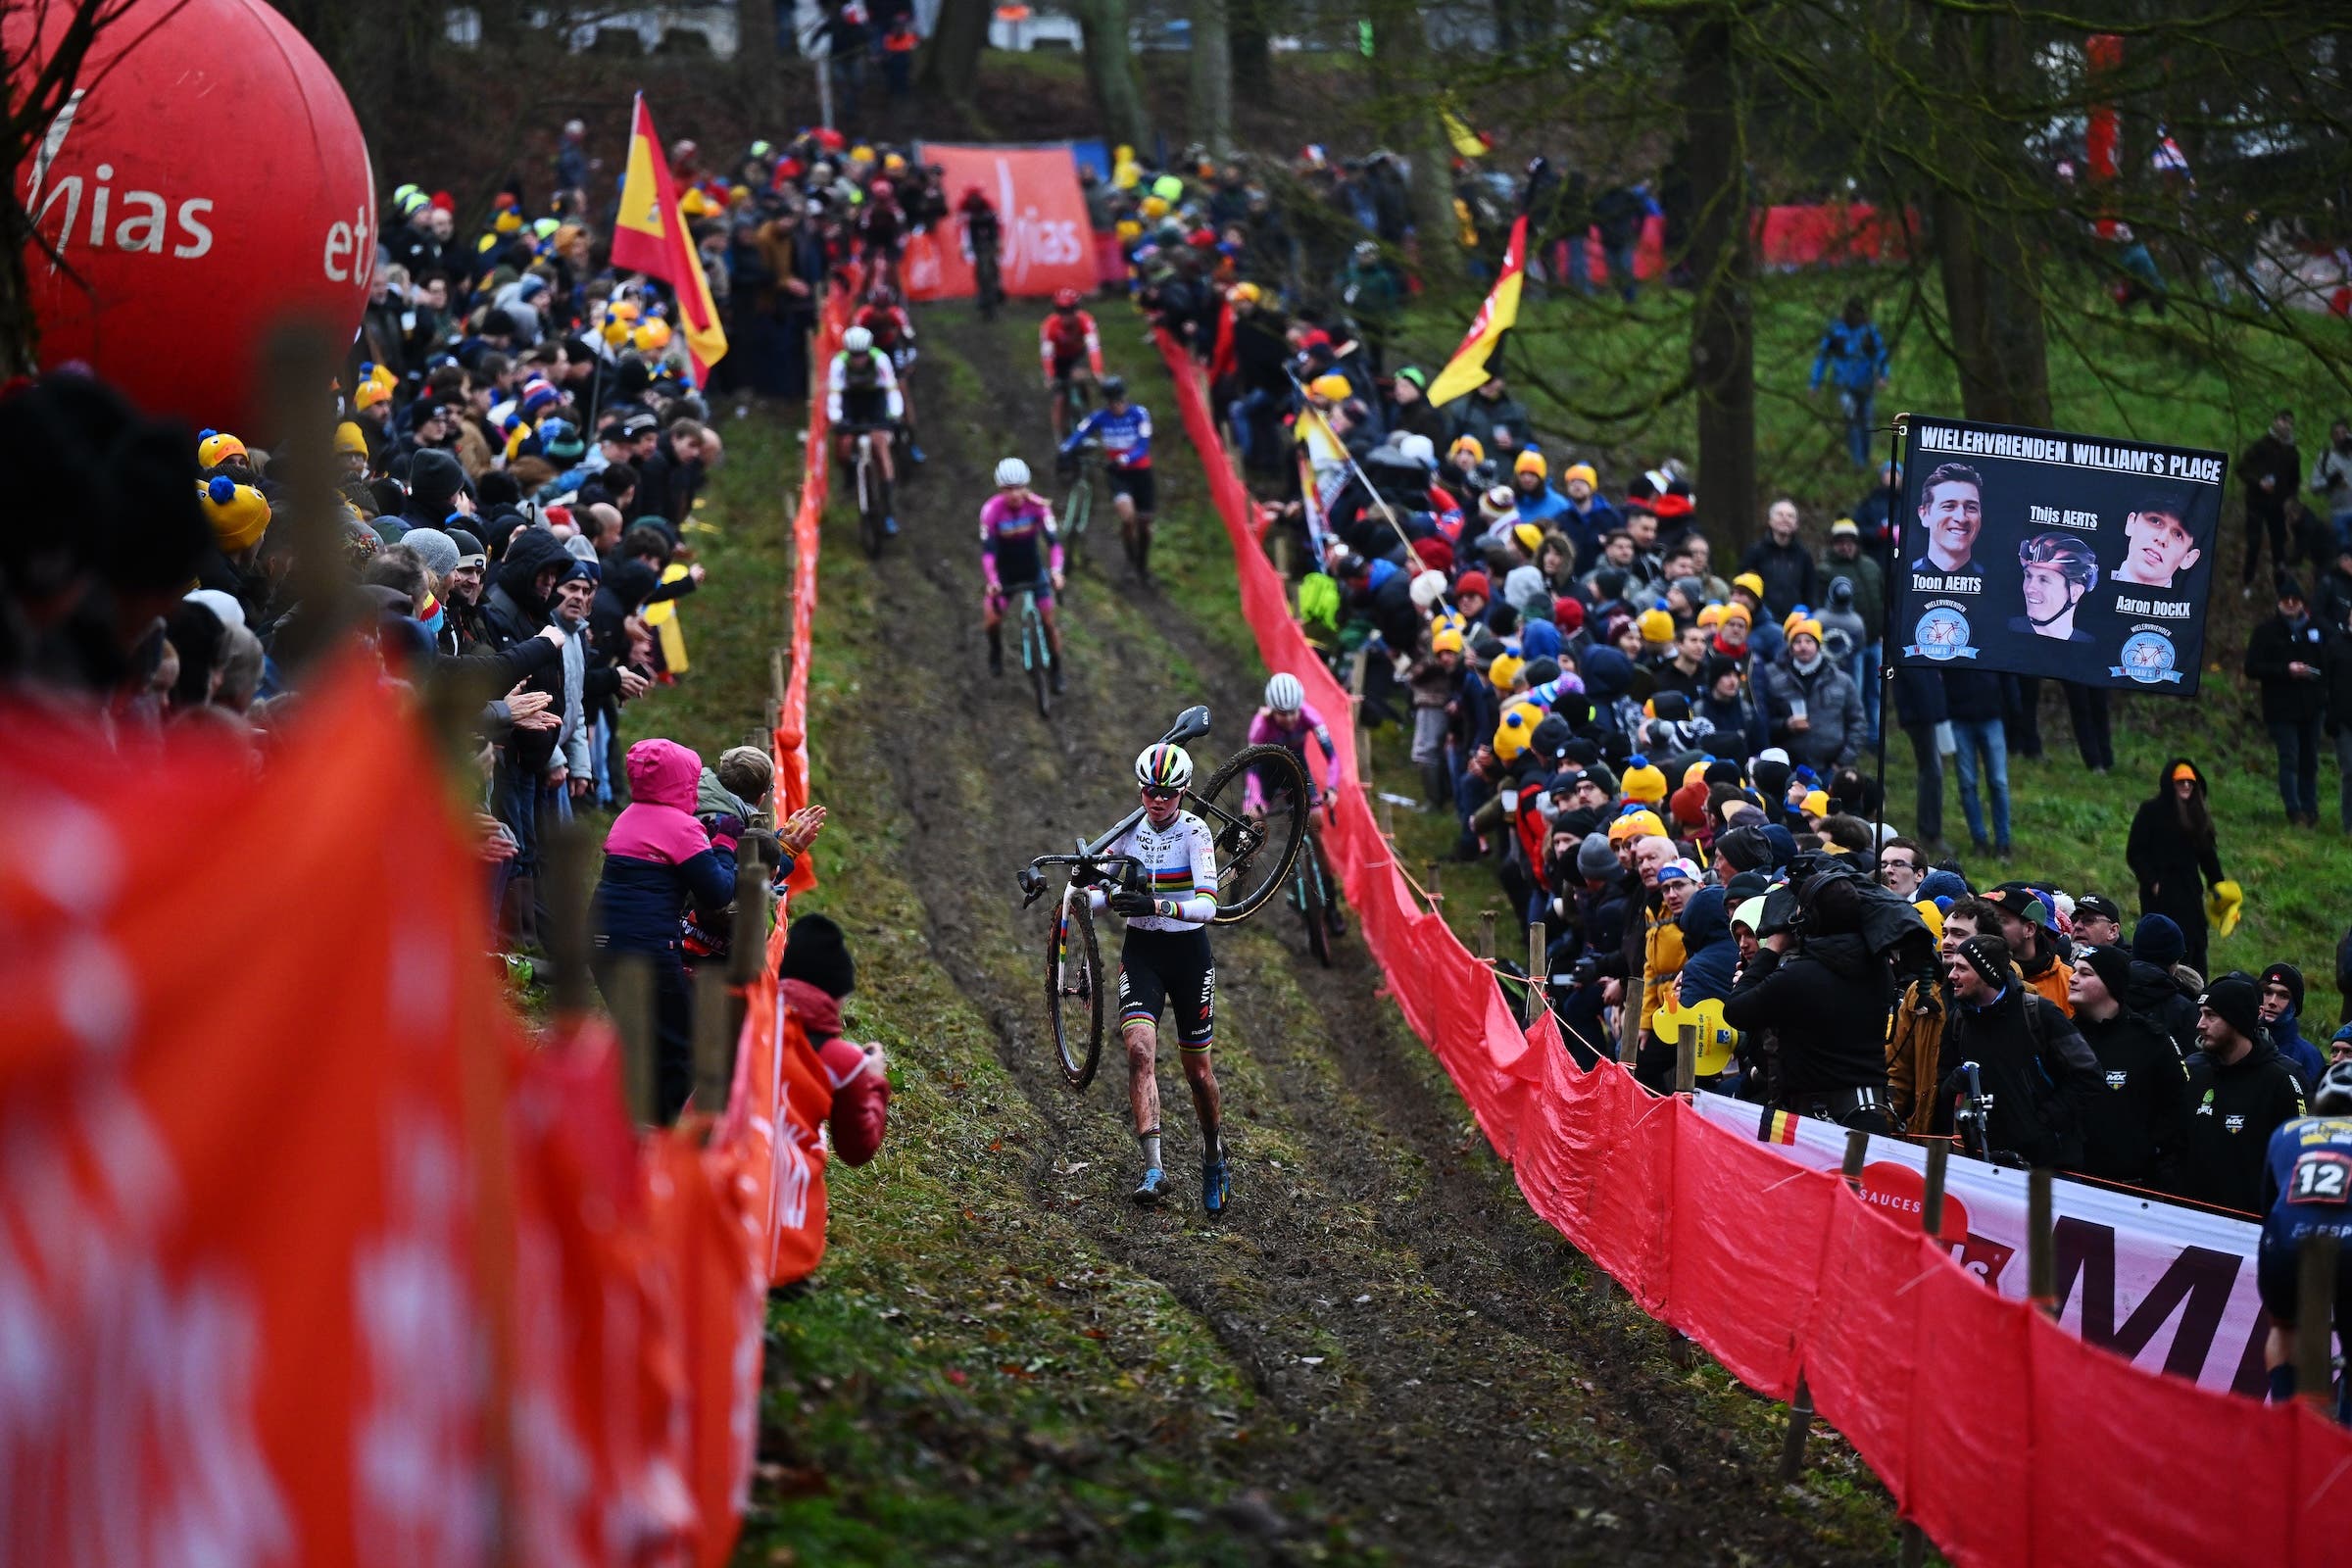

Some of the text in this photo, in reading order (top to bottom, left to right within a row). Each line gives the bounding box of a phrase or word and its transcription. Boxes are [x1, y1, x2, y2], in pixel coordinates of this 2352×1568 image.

[1921, 426, 2222, 481] WIELERVRIENDEN WILLIAM'S PLACE
[2031, 506, 2098, 528] Thijs AERTS
[1913, 574, 1982, 592] Toon AERTS
[1924, 599, 1967, 612] WIELERVRIENDEN
[2116, 596, 2190, 616] Aaron DOCKX
[2131, 623, 2172, 637] WIELERVRIENDEN
[1200, 968, 1213, 1004] VISMA
[2299, 1163, 2344, 1196] 12
[1858, 1189, 1922, 1213] SAUCES
